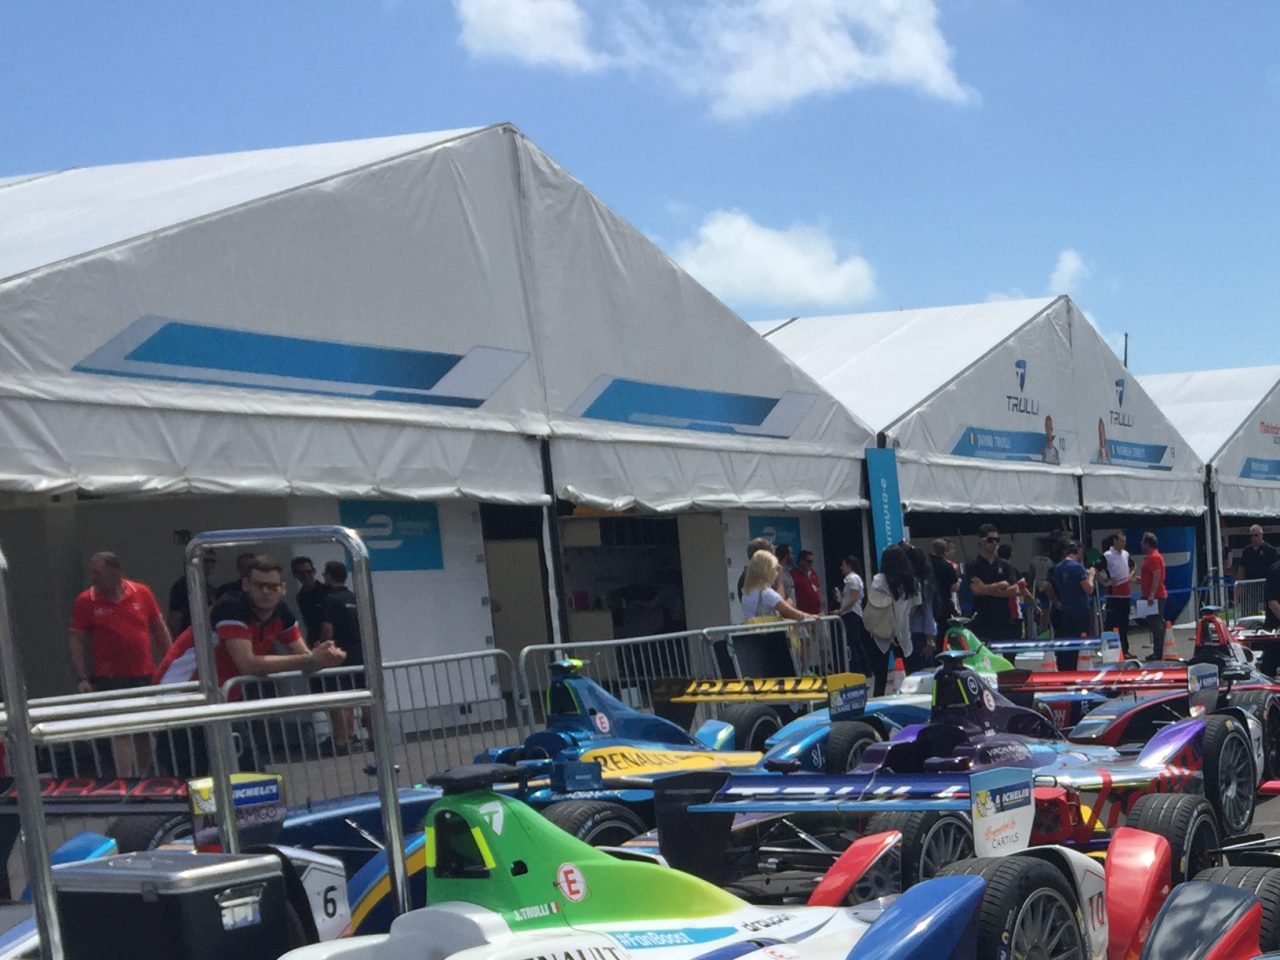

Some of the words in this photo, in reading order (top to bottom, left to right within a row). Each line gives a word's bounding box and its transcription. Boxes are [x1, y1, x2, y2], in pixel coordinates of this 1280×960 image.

[1006, 396, 1040, 416] TRULLI
[592, 750, 675, 774] RENAULT
[231, 783, 279, 800] ICHELIN
[563, 868, 581, 895] E
[322, 886, 337, 919] 6
[615, 930, 696, 949] #FanBoost
